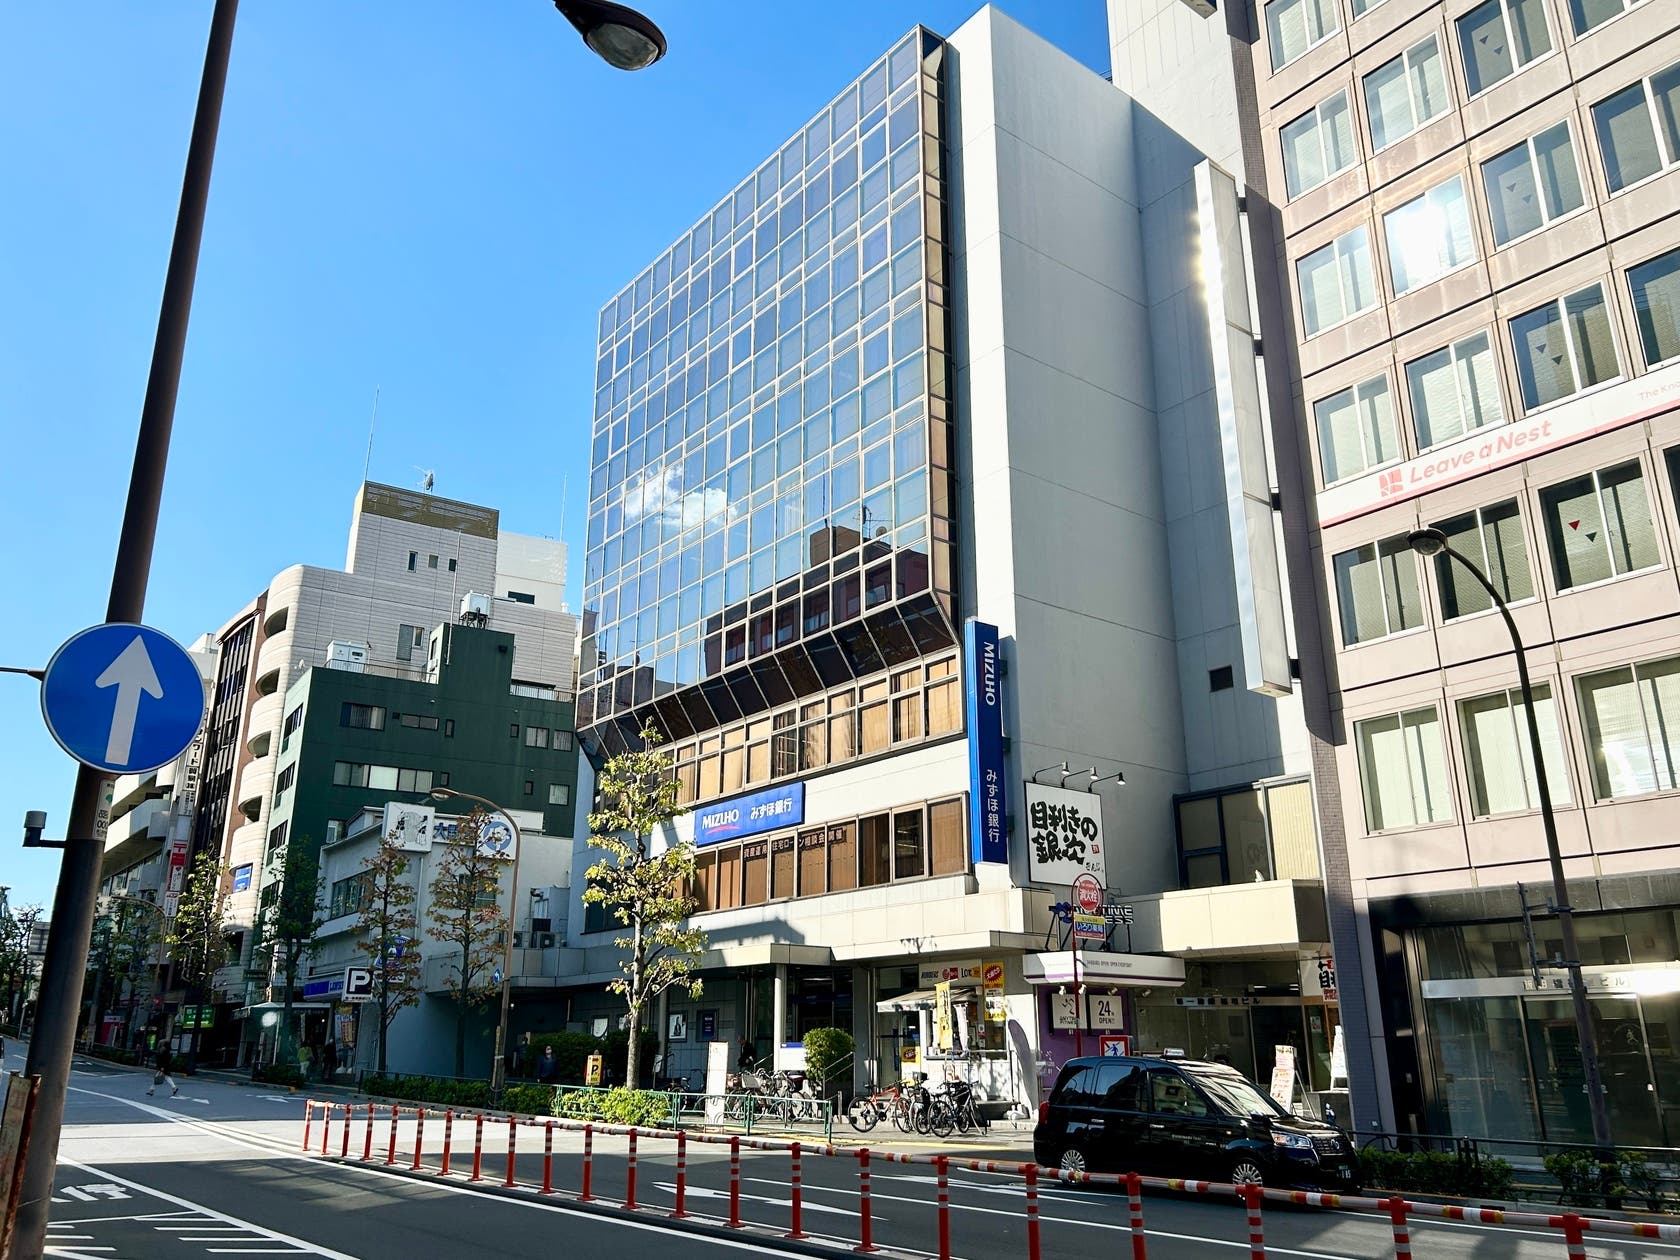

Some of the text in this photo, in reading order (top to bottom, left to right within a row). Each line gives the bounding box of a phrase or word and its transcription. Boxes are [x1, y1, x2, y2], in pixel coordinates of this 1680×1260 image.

[1409, 420, 1553, 484] Leave a Nest
[983, 641, 997, 706] MIZUHO
[701, 797, 793, 830] MIZUHO みずほ銀行
[986, 768, 1000, 844] みずほ銀行
[1030, 800, 1098, 842] 目利きの
[1031, 830, 1086, 865] 銀次
[1079, 888, 1098, 903] 消火栓
[349, 970, 370, 992] P
[591, 1064, 599, 1076] P
